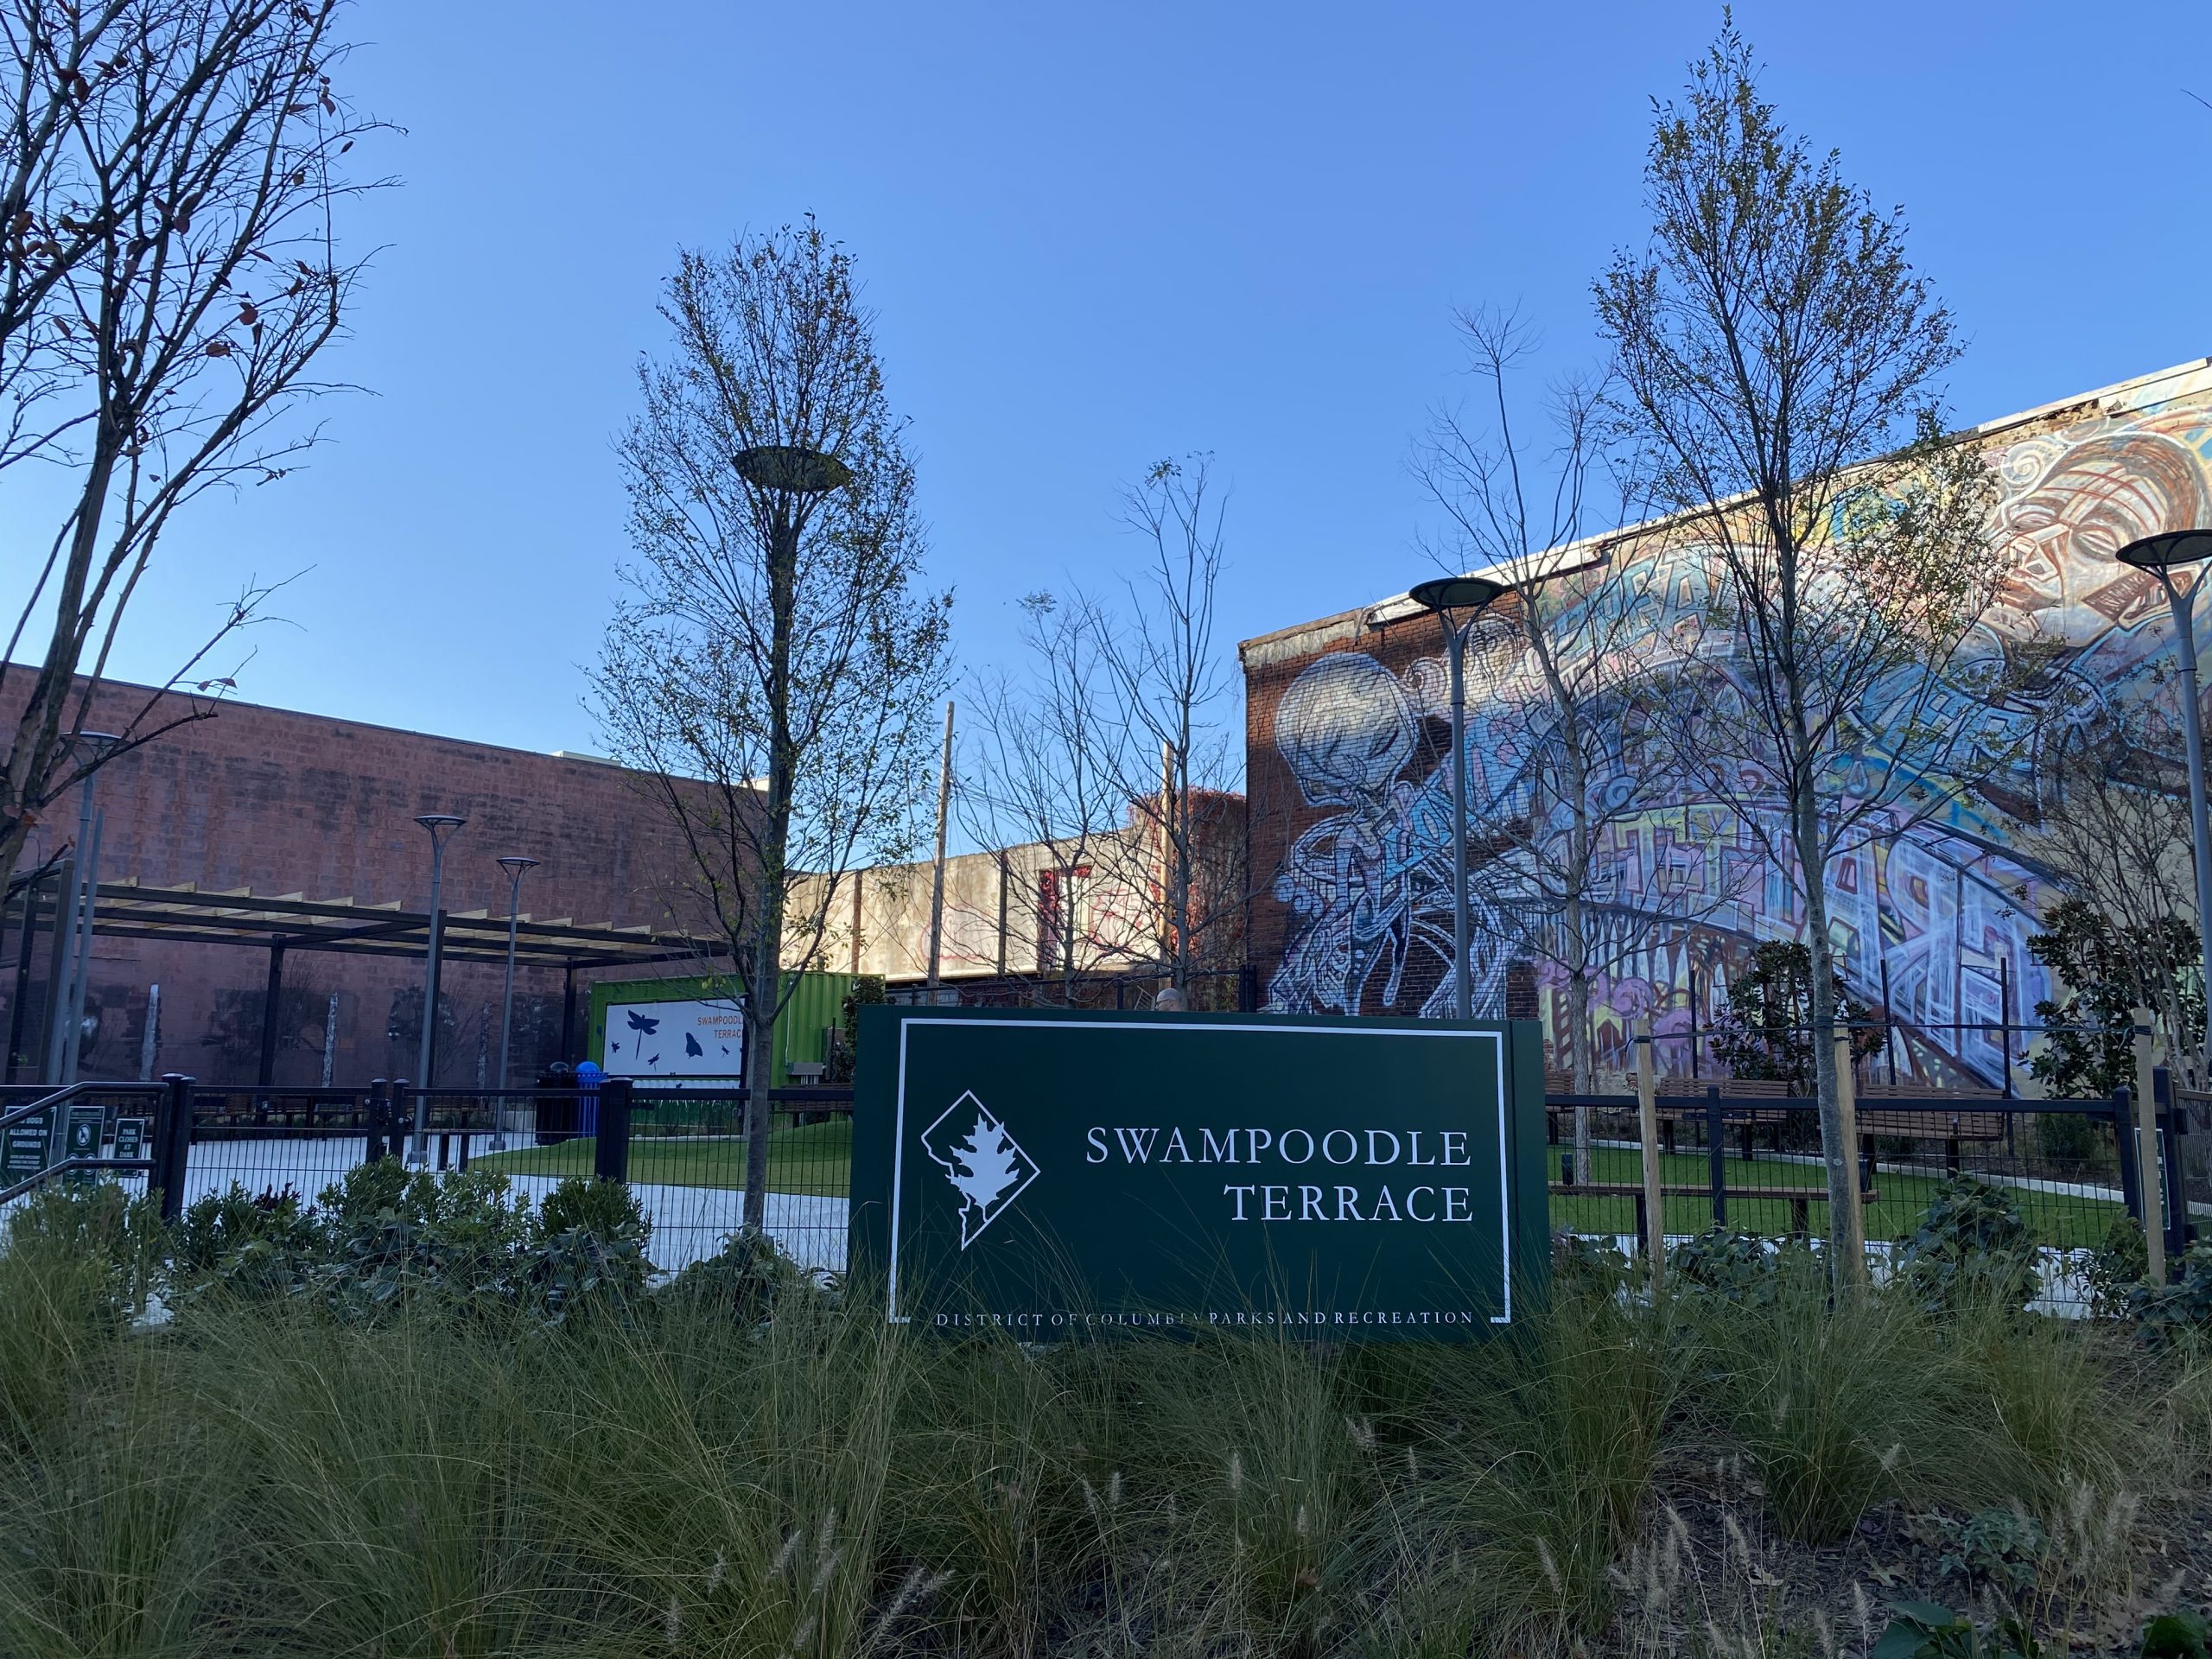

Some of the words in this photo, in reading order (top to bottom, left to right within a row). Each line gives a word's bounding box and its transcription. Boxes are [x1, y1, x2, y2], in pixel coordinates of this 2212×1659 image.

[697, 1015, 743, 1026] SWAMPOODL
[714, 1029, 741, 1039] TERRAC
[1086, 1127, 1471, 1166] SWAMPOODLE
[1224, 1185, 1473, 1222] TERRACE
[937, 1313, 1043, 1326] DISTRICT
[1051, 1313, 1077, 1326] OF
[1210, 1312, 1274, 1325] PARKS
[1283, 1312, 1326, 1325] AND
[1334, 1311, 1472, 1325] RECREATION
